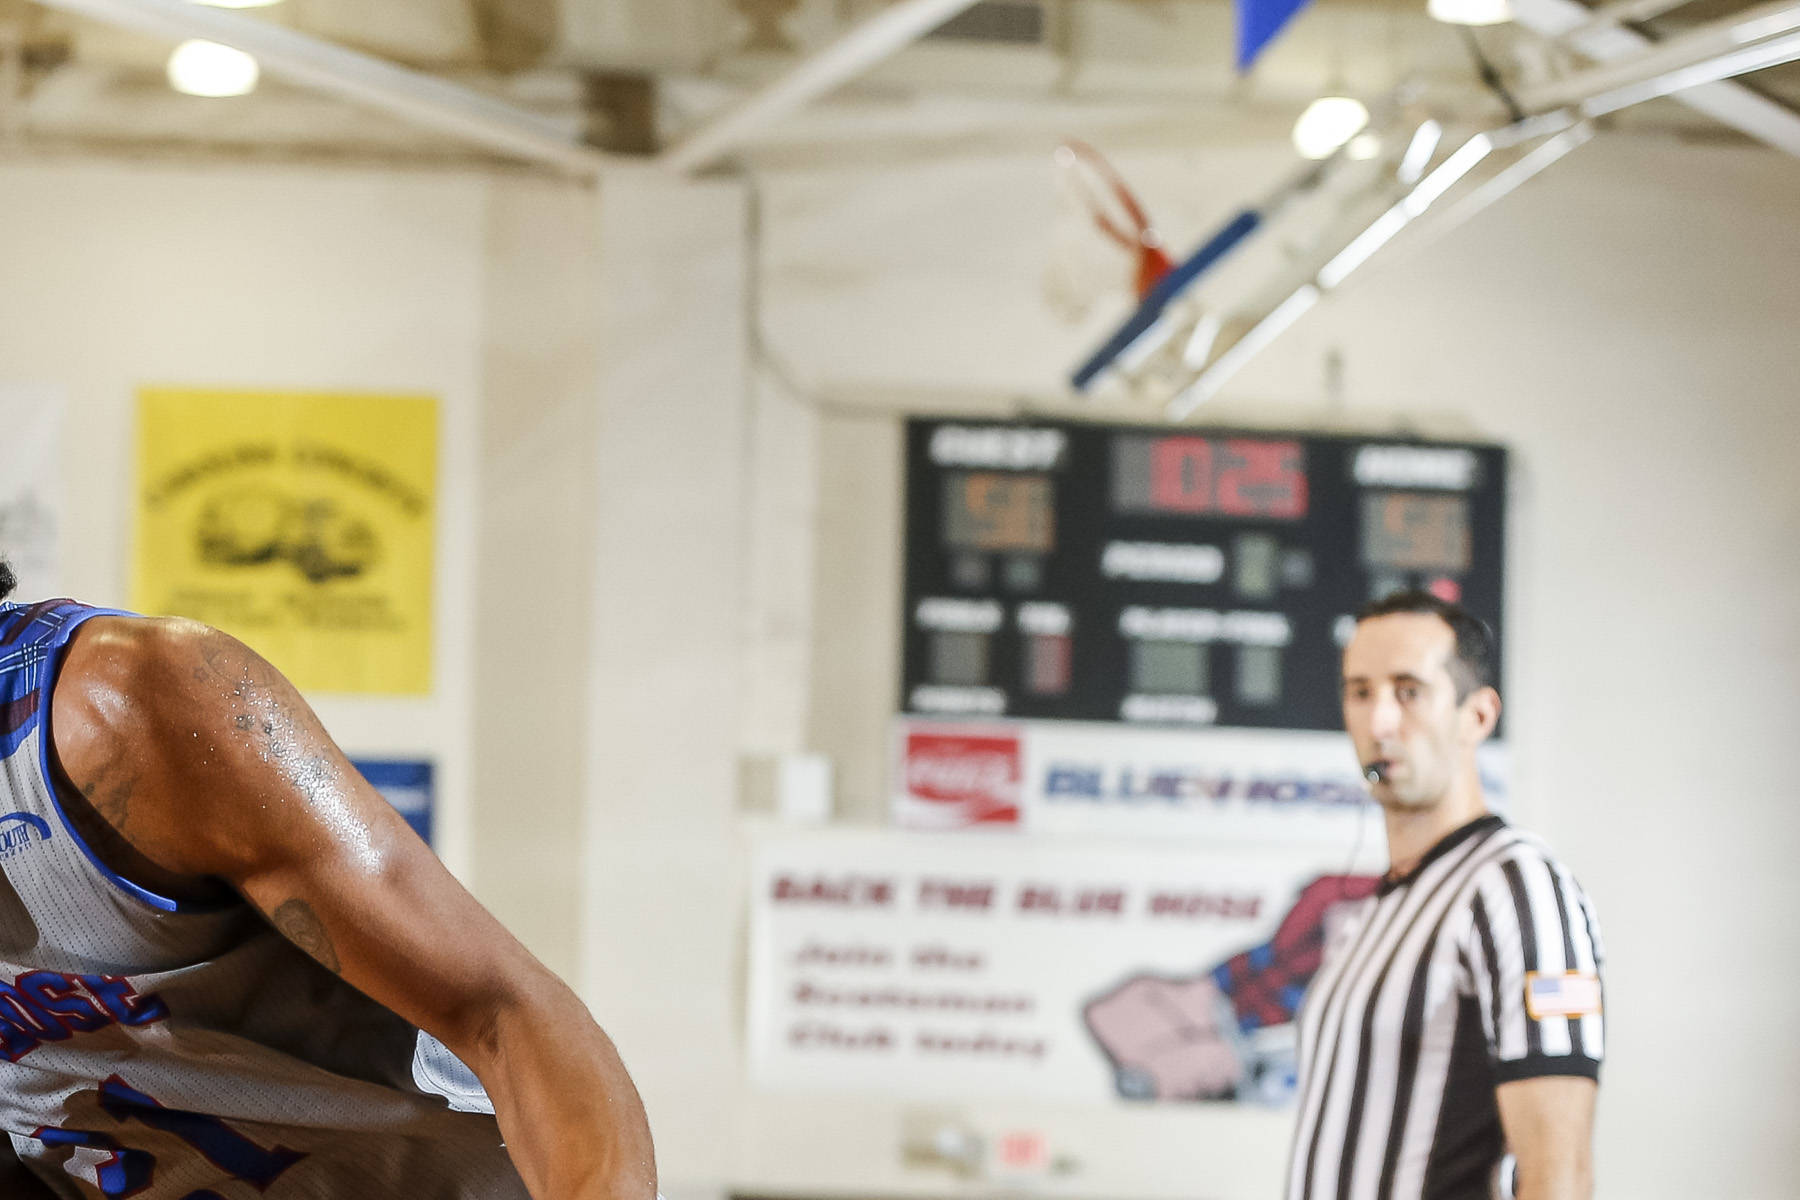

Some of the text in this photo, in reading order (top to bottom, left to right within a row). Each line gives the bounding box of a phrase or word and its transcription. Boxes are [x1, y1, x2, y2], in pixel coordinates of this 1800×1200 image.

[1208, 775, 1368, 813] HOS
[772, 872, 1264, 920] BACK THE BLUE HOSE
